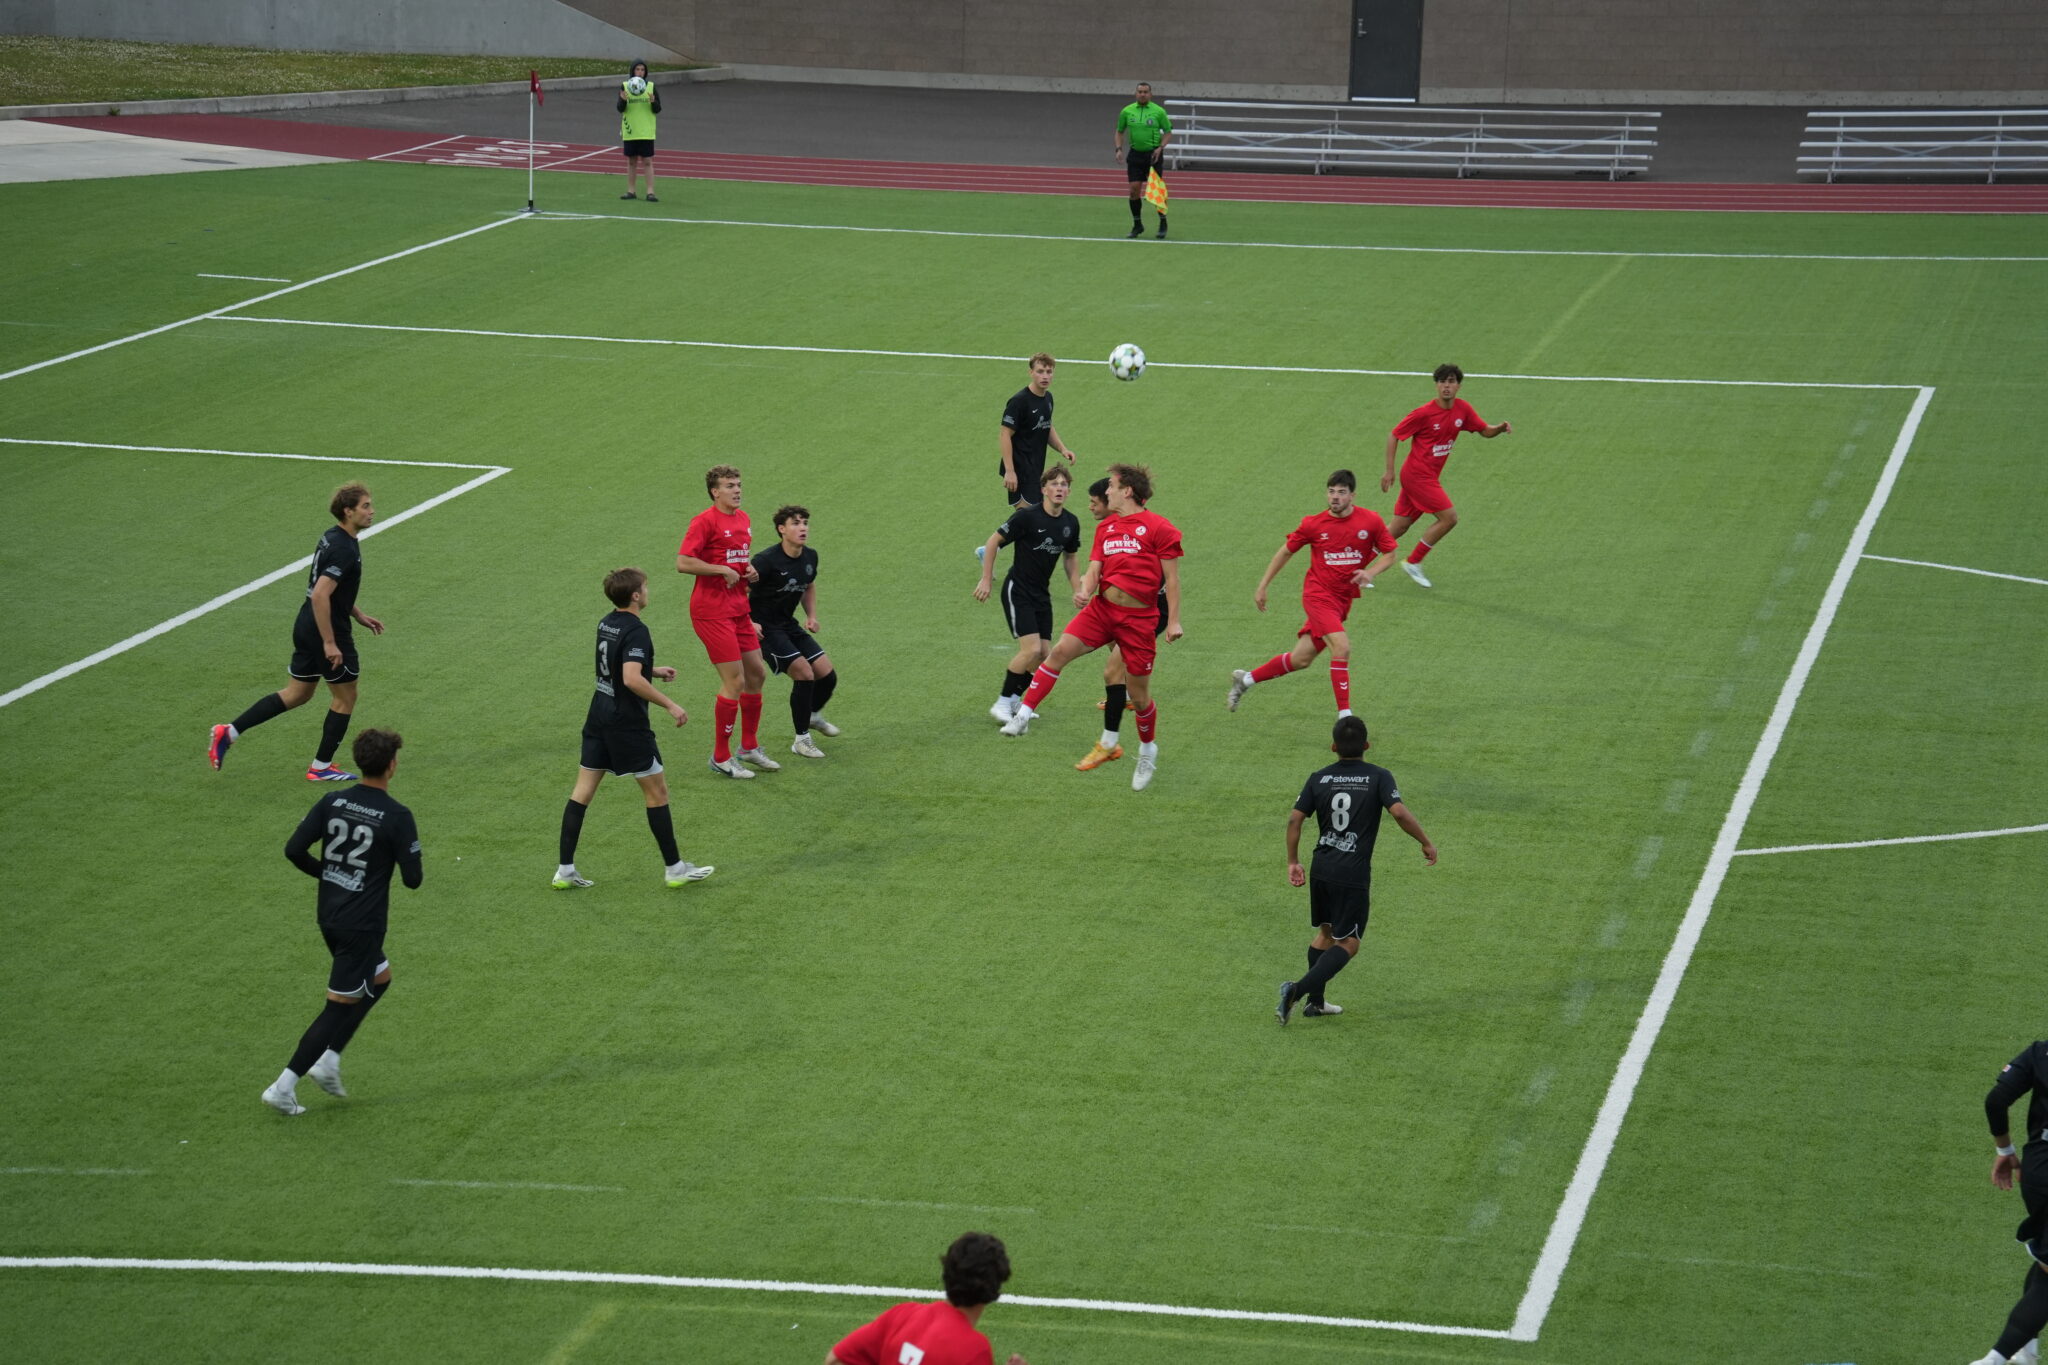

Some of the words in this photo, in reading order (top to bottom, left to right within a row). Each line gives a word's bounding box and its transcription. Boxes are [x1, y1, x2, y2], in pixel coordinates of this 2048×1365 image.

[1333, 775, 1370, 783] stewart
[345, 802, 385, 820] stewart
[1331, 792, 1352, 832] 8
[324, 817, 374, 869] 22
